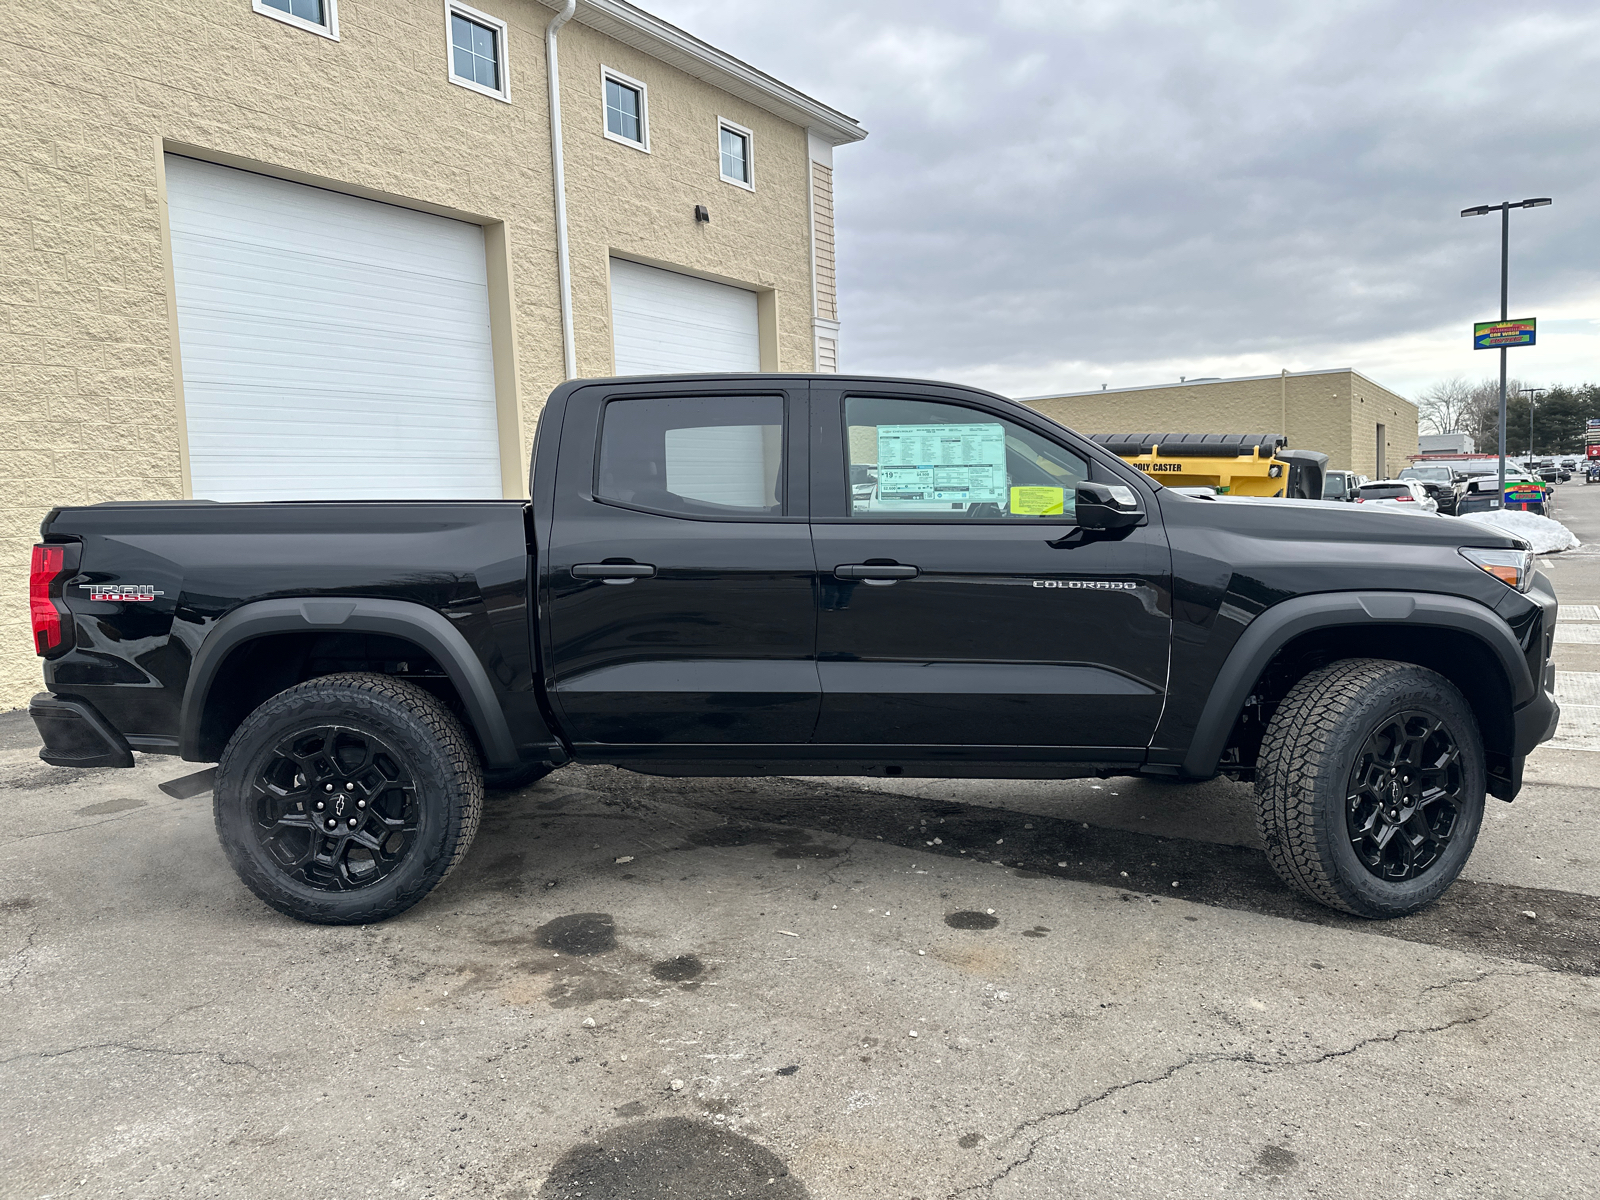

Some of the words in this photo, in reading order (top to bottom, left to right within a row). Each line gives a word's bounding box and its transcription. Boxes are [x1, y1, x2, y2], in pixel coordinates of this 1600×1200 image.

[1153, 463, 1182, 472] CASTER
[79, 585, 164, 595] TRAIL
[1032, 580, 1137, 590] COLORADO
